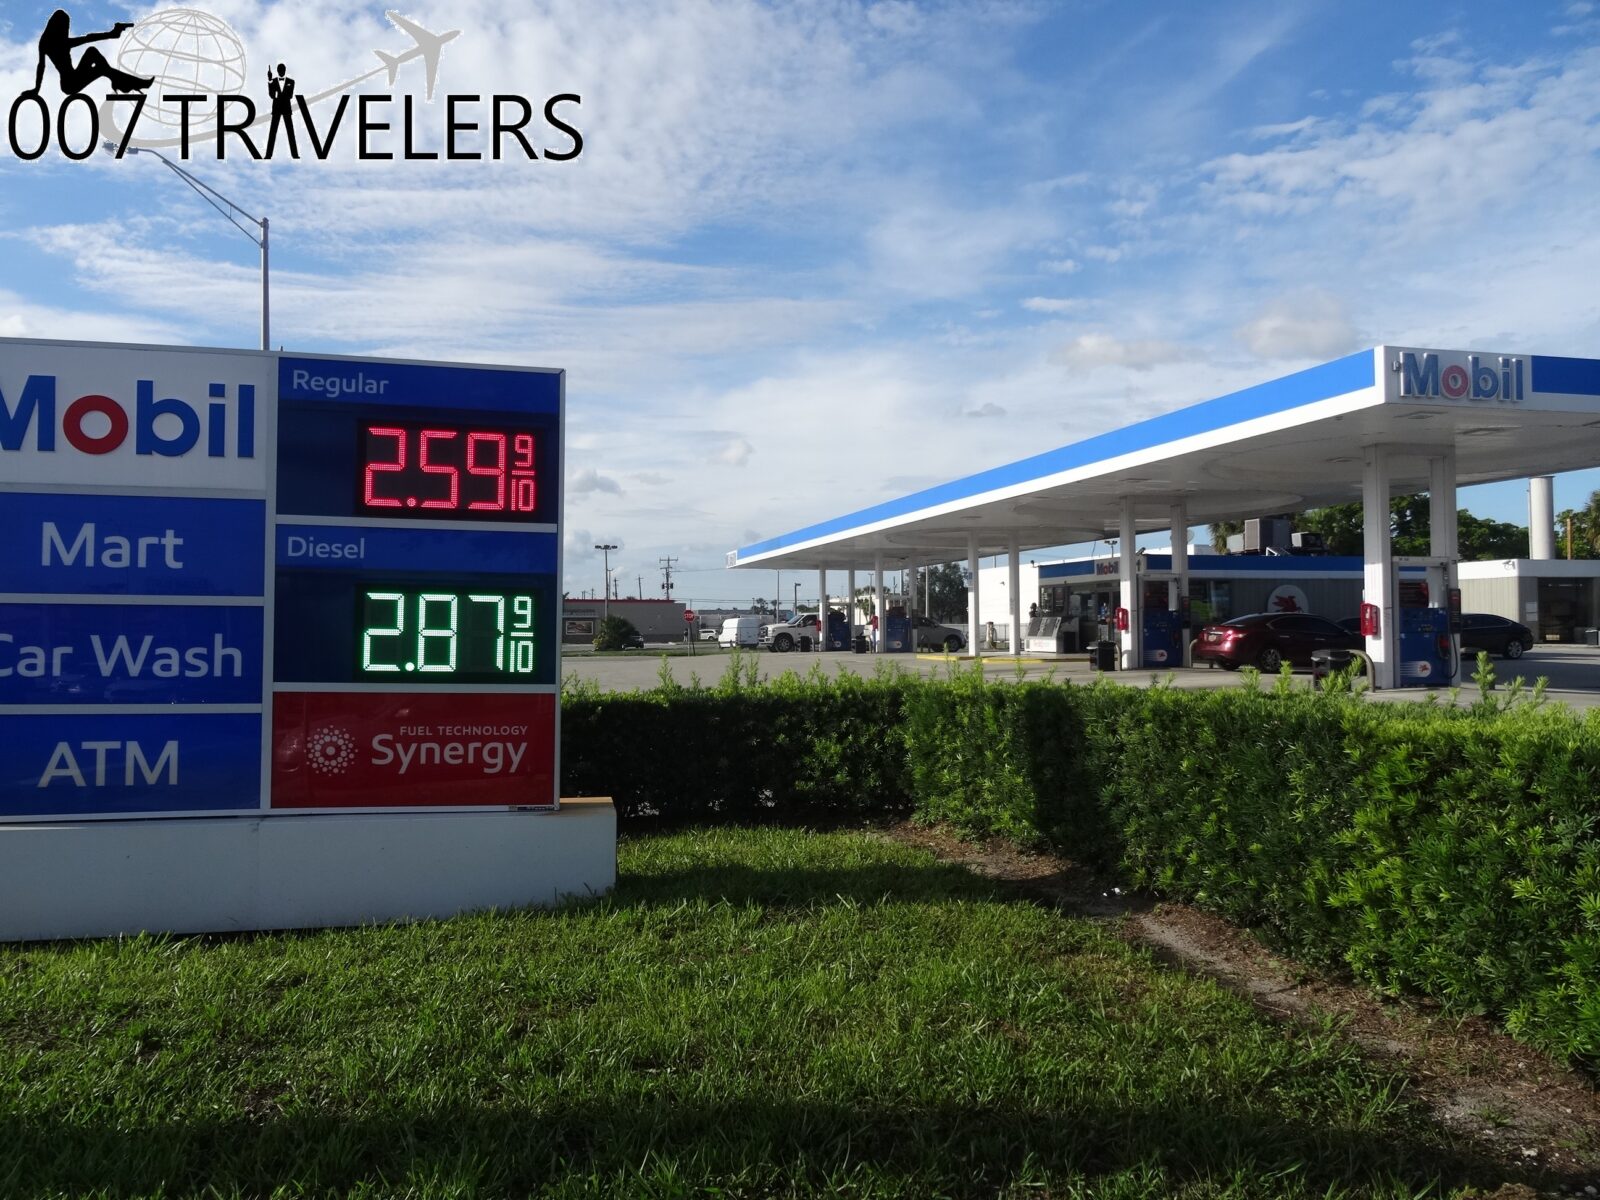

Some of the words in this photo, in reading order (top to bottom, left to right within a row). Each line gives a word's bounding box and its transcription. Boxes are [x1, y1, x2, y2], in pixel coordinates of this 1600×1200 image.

[293, 369, 390, 398] Regular
[1399, 350, 1525, 402] Mobil
[0, 375, 255, 458] Mobil
[365, 427, 506, 511] 2.59
[41, 521, 184, 569] Mart
[287, 536, 365, 559] Diesel
[1096, 560, 1119, 576] Mobil
[90, 633, 242, 677] Wash
[363, 592, 505, 673] 2.87
[371, 733, 528, 774] Synergy
[400, 726, 432, 736] FUEL
[437, 726, 528, 736] TECHNOLOGY
[37, 740, 179, 787] ATM
